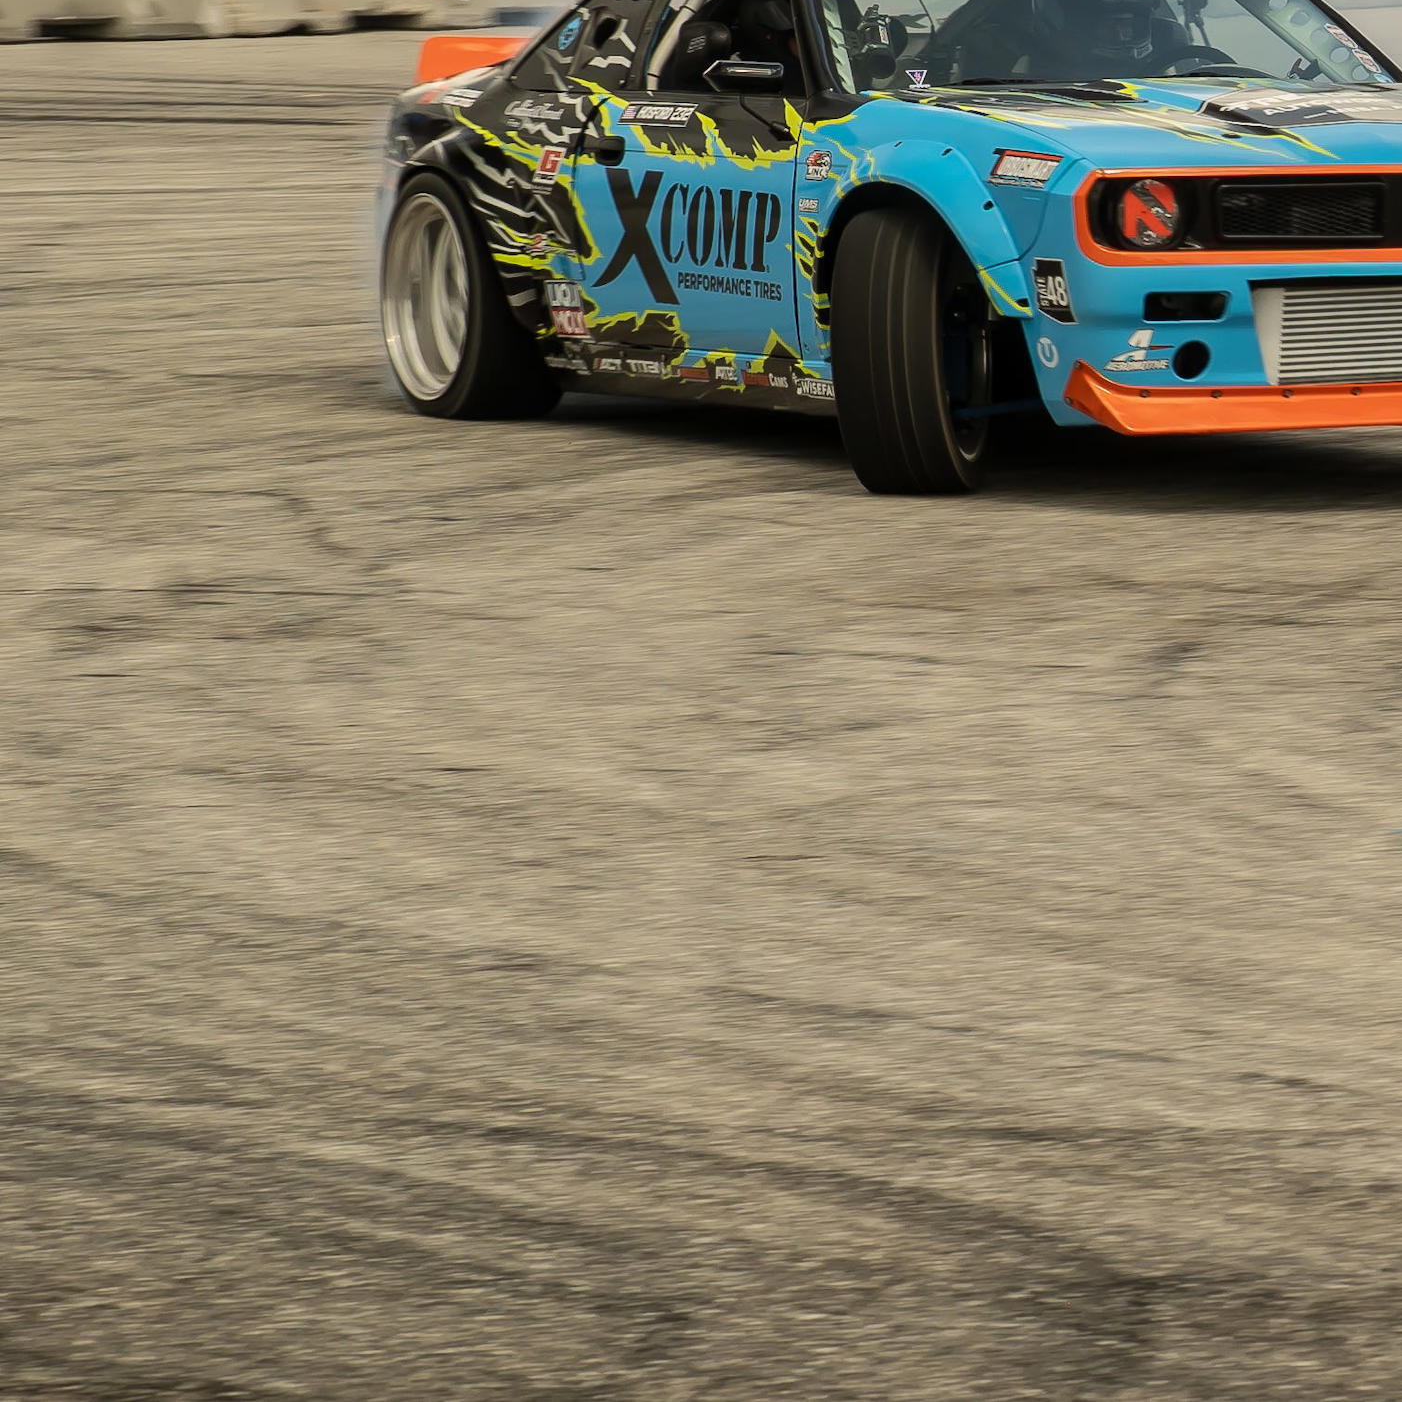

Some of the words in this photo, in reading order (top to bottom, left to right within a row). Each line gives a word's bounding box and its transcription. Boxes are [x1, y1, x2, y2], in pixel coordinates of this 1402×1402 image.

[677, 271, 752, 297] PERFORMANCE
[753, 279, 782, 302] TIRES
[1047, 275, 1069, 307] 48
[801, 379, 836, 397] WISEFA
